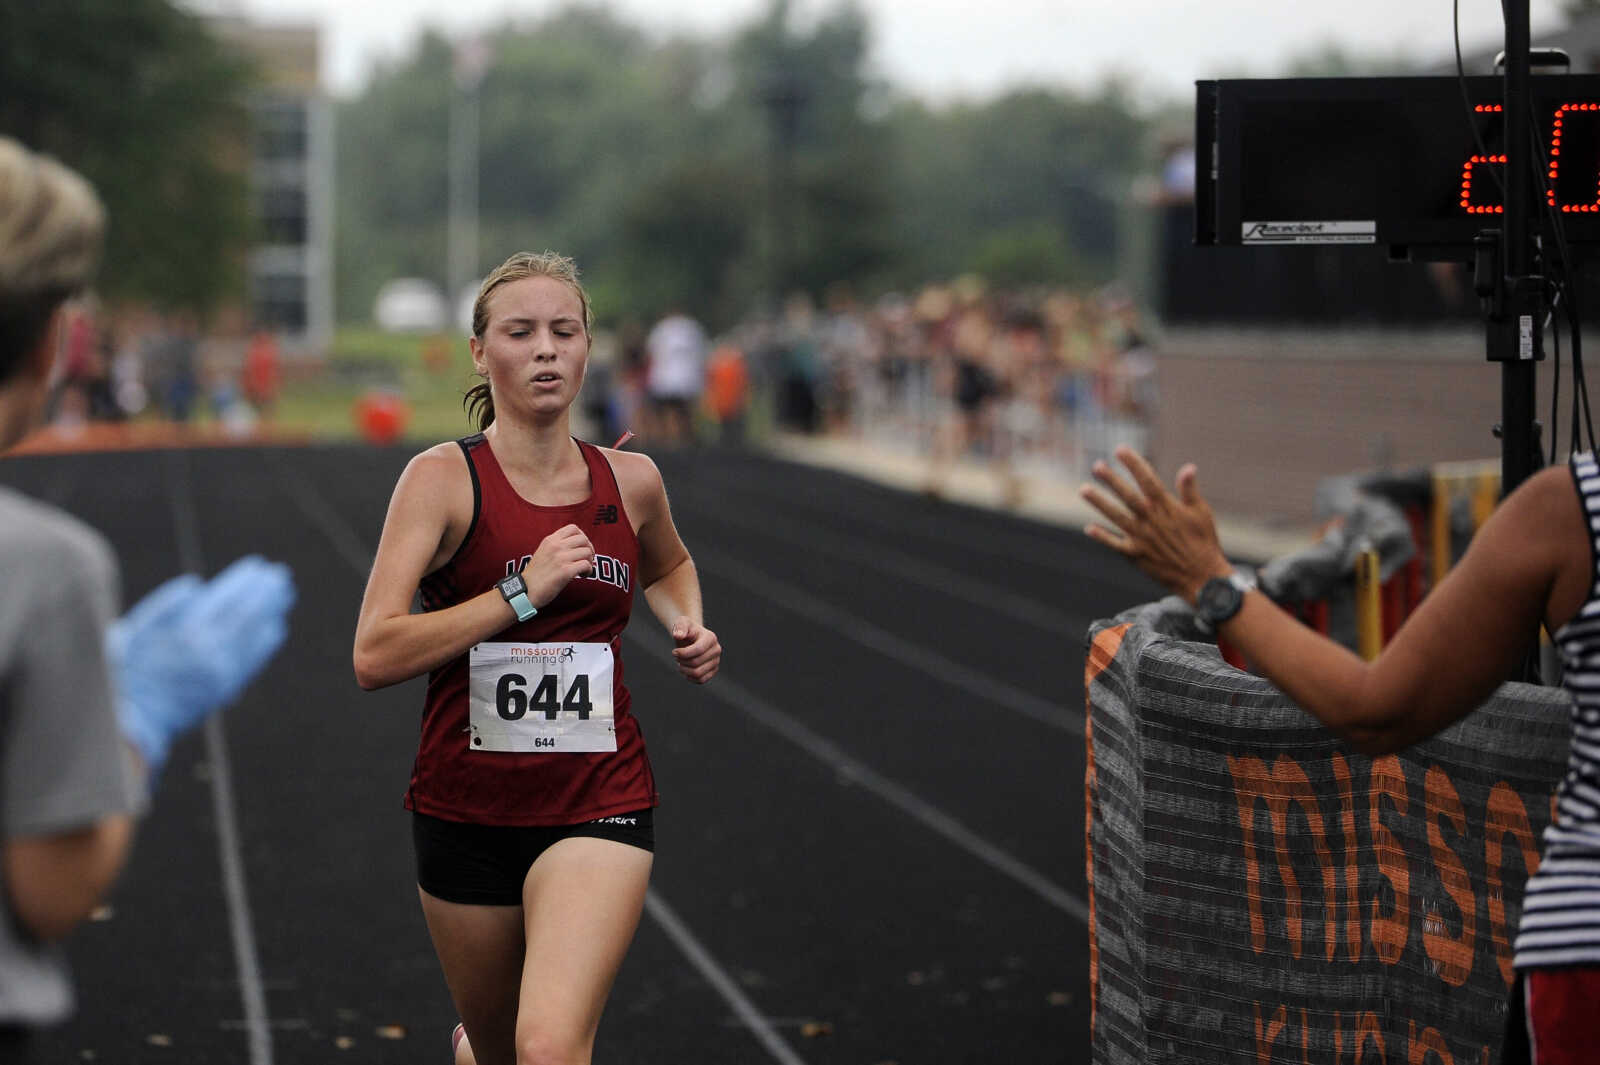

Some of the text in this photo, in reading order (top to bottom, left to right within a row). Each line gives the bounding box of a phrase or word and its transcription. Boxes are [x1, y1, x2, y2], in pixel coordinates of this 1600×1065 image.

[510, 647, 565, 656] missouri
[510, 655, 557, 666] running
[496, 672, 593, 721] 644
[534, 737, 555, 748] 644
[1226, 752, 1558, 989] misso
